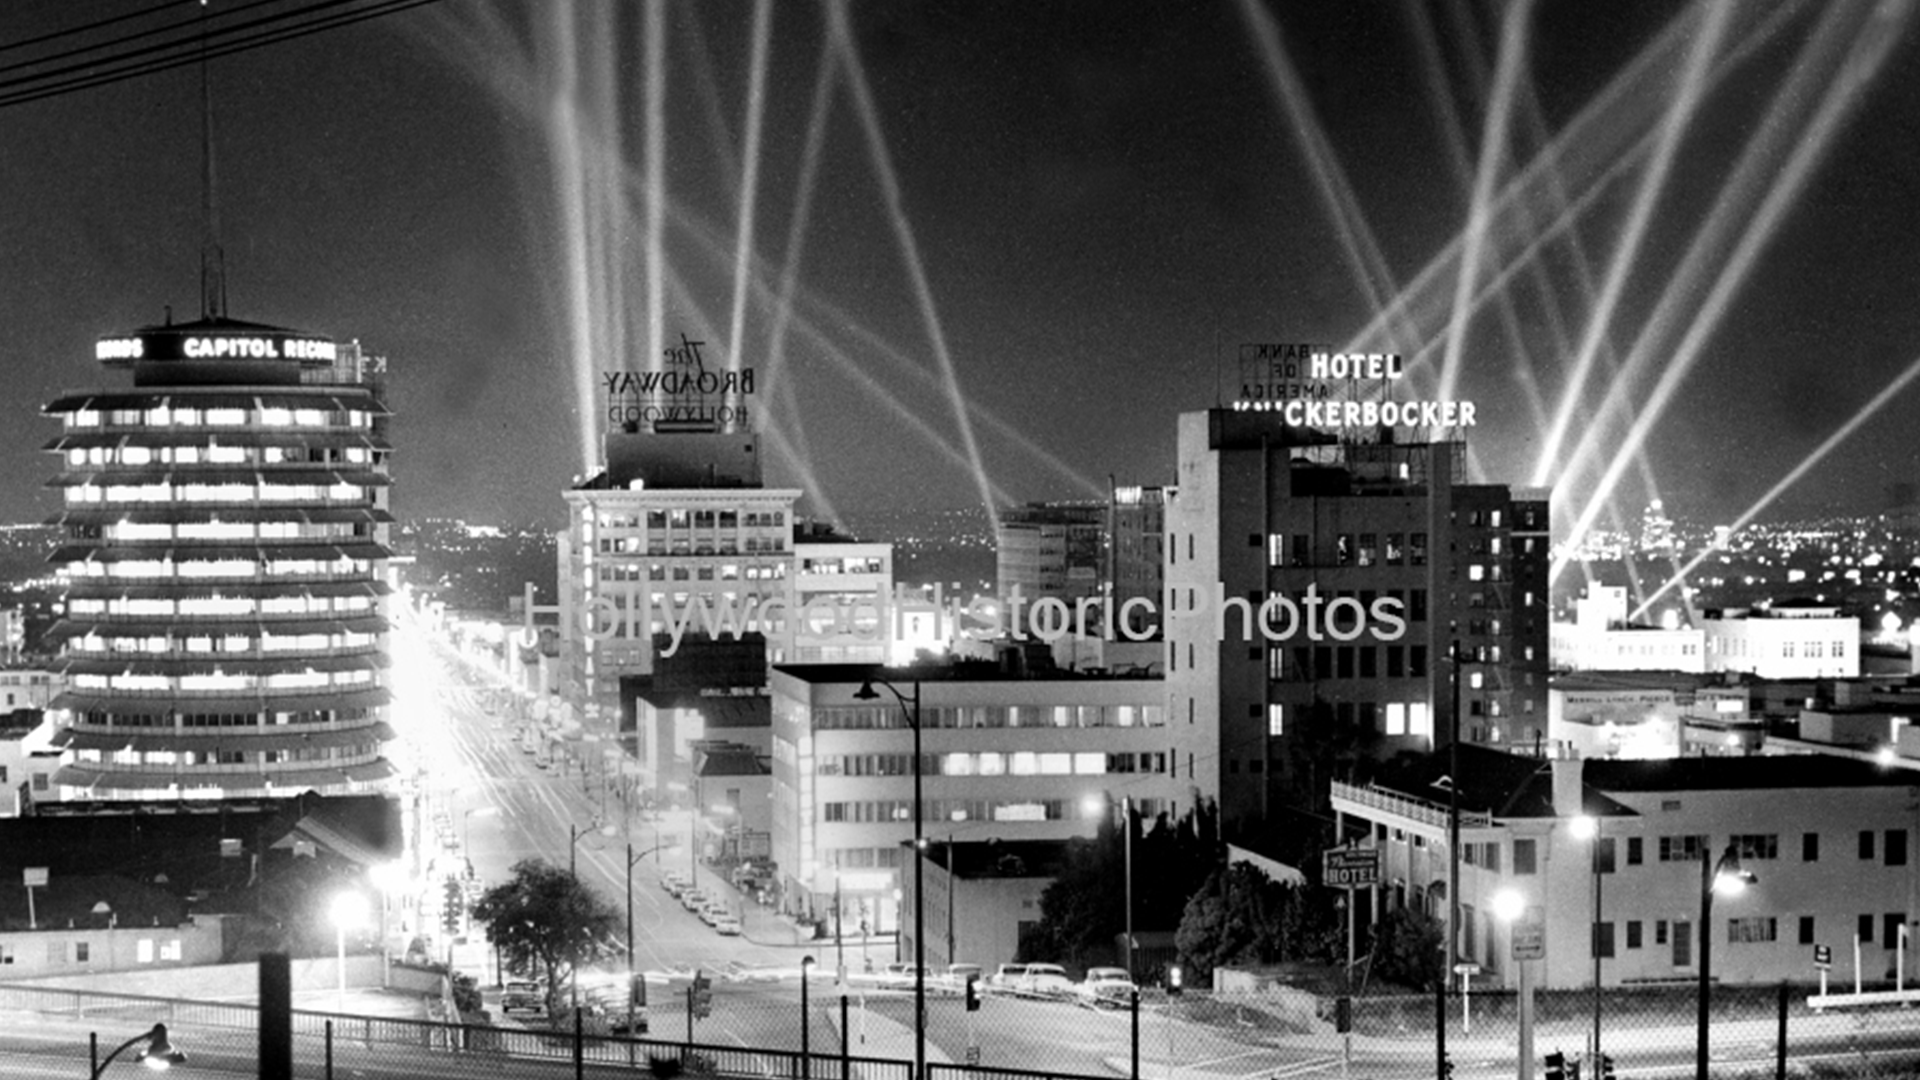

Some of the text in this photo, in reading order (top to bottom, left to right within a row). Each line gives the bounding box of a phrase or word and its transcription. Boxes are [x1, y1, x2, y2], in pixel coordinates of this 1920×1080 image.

[183, 338, 279, 358] CAPITOL
[1311, 353, 1402, 379] HOTEL
[1329, 868, 1377, 883] HOTEL
